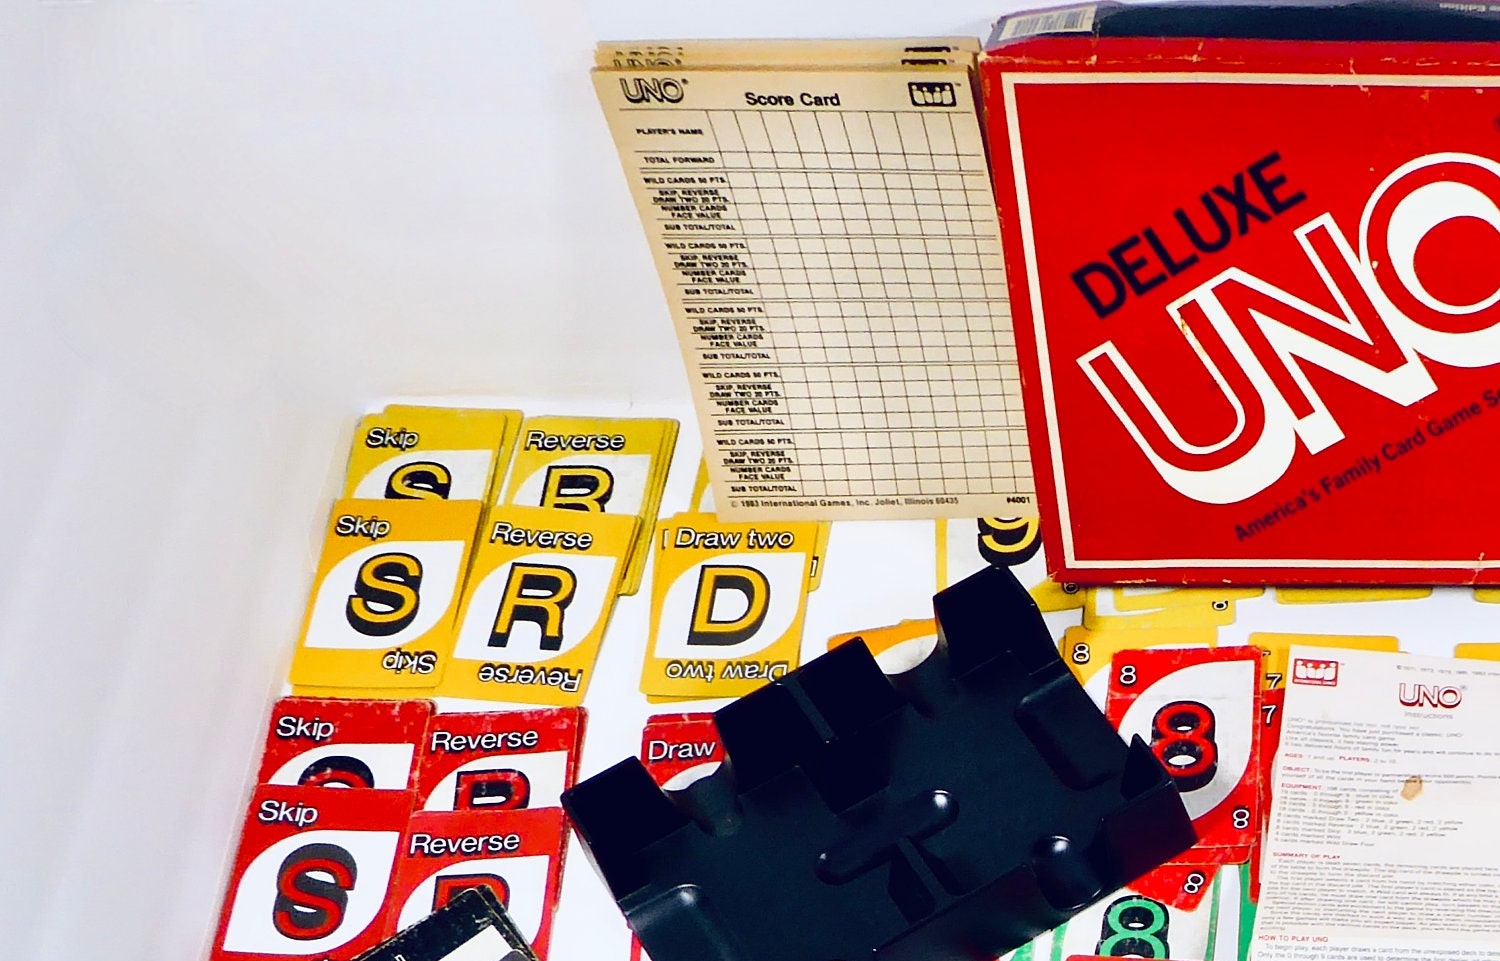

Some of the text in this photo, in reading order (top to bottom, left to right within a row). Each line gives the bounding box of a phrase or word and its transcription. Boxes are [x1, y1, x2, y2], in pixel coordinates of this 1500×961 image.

[620, 78, 684, 103] UNO
[746, 92, 840, 106] Score Card
[1071, 153, 1307, 318] DELUXE
[365, 428, 419, 451] Skip
[525, 429, 625, 452] Reverse
[1234, 489, 1321, 541] America's
[1320, 453, 1383, 495] Family
[1382, 429, 1426, 461] Card
[1426, 401, 1483, 436] Game
[761, 499, 817, 507] International
[905, 498, 934, 506] Illinois
[336, 515, 390, 539] Skip
[491, 524, 593, 549] Reverse
[675, 527, 794, 548] Draw two
[346, 552, 422, 638] S
[488, 562, 578, 650] R
[688, 564, 771, 646] D
[381, 649, 436, 675] Skip
[666, 661, 723, 681] two
[479, 665, 582, 692] Reverse
[1400, 682, 1462, 708] UNO
[1405, 711, 1453, 720] Instructions
[276, 717, 334, 740] Skip
[431, 728, 539, 751] Reverse
[647, 739, 716, 762] Draw
[1149, 700, 1218, 792] 8
[258, 800, 318, 825] Skip
[410, 832, 520, 855] Reverse
[273, 842, 358, 941] S
